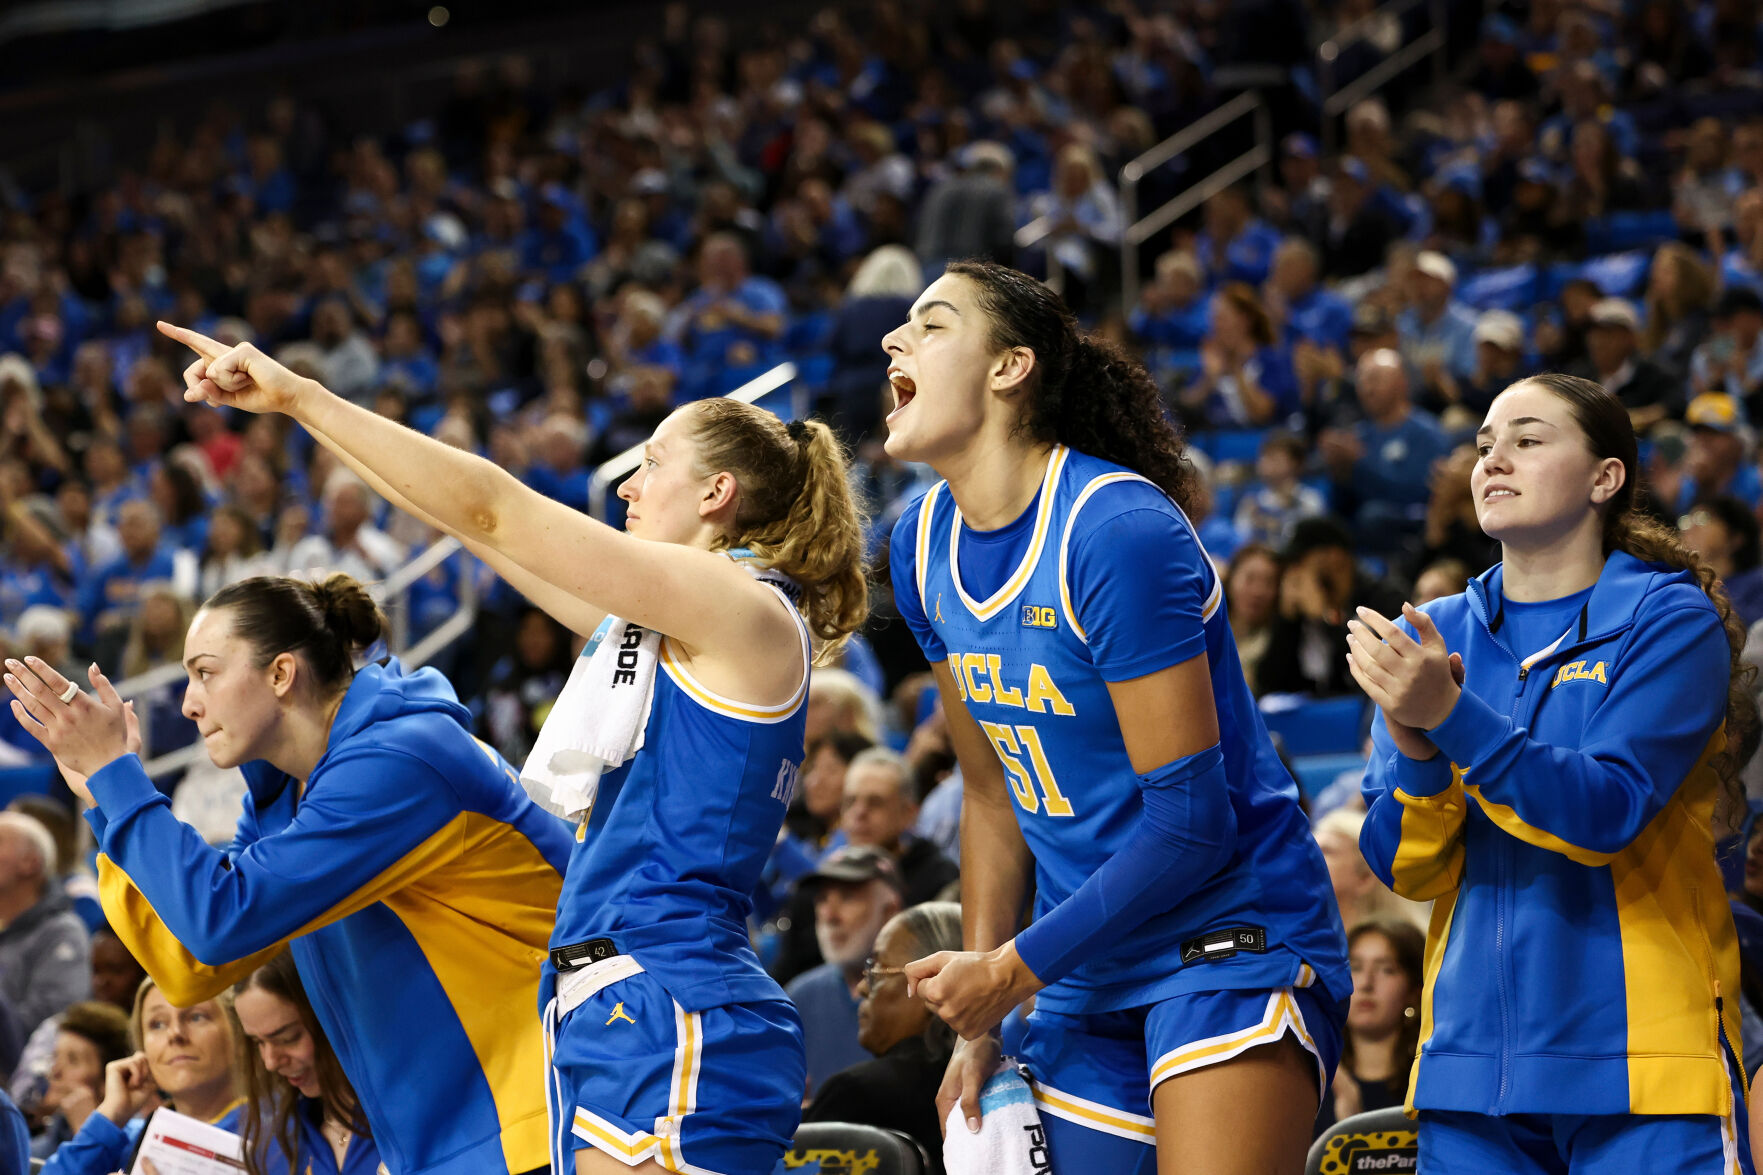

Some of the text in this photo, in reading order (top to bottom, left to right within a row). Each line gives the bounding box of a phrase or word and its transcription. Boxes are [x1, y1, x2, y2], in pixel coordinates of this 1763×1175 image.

[947, 652, 1076, 716] UCLA
[978, 719, 1075, 816] 51
[594, 946, 606, 957] 42
[1239, 933, 1254, 944] 50
